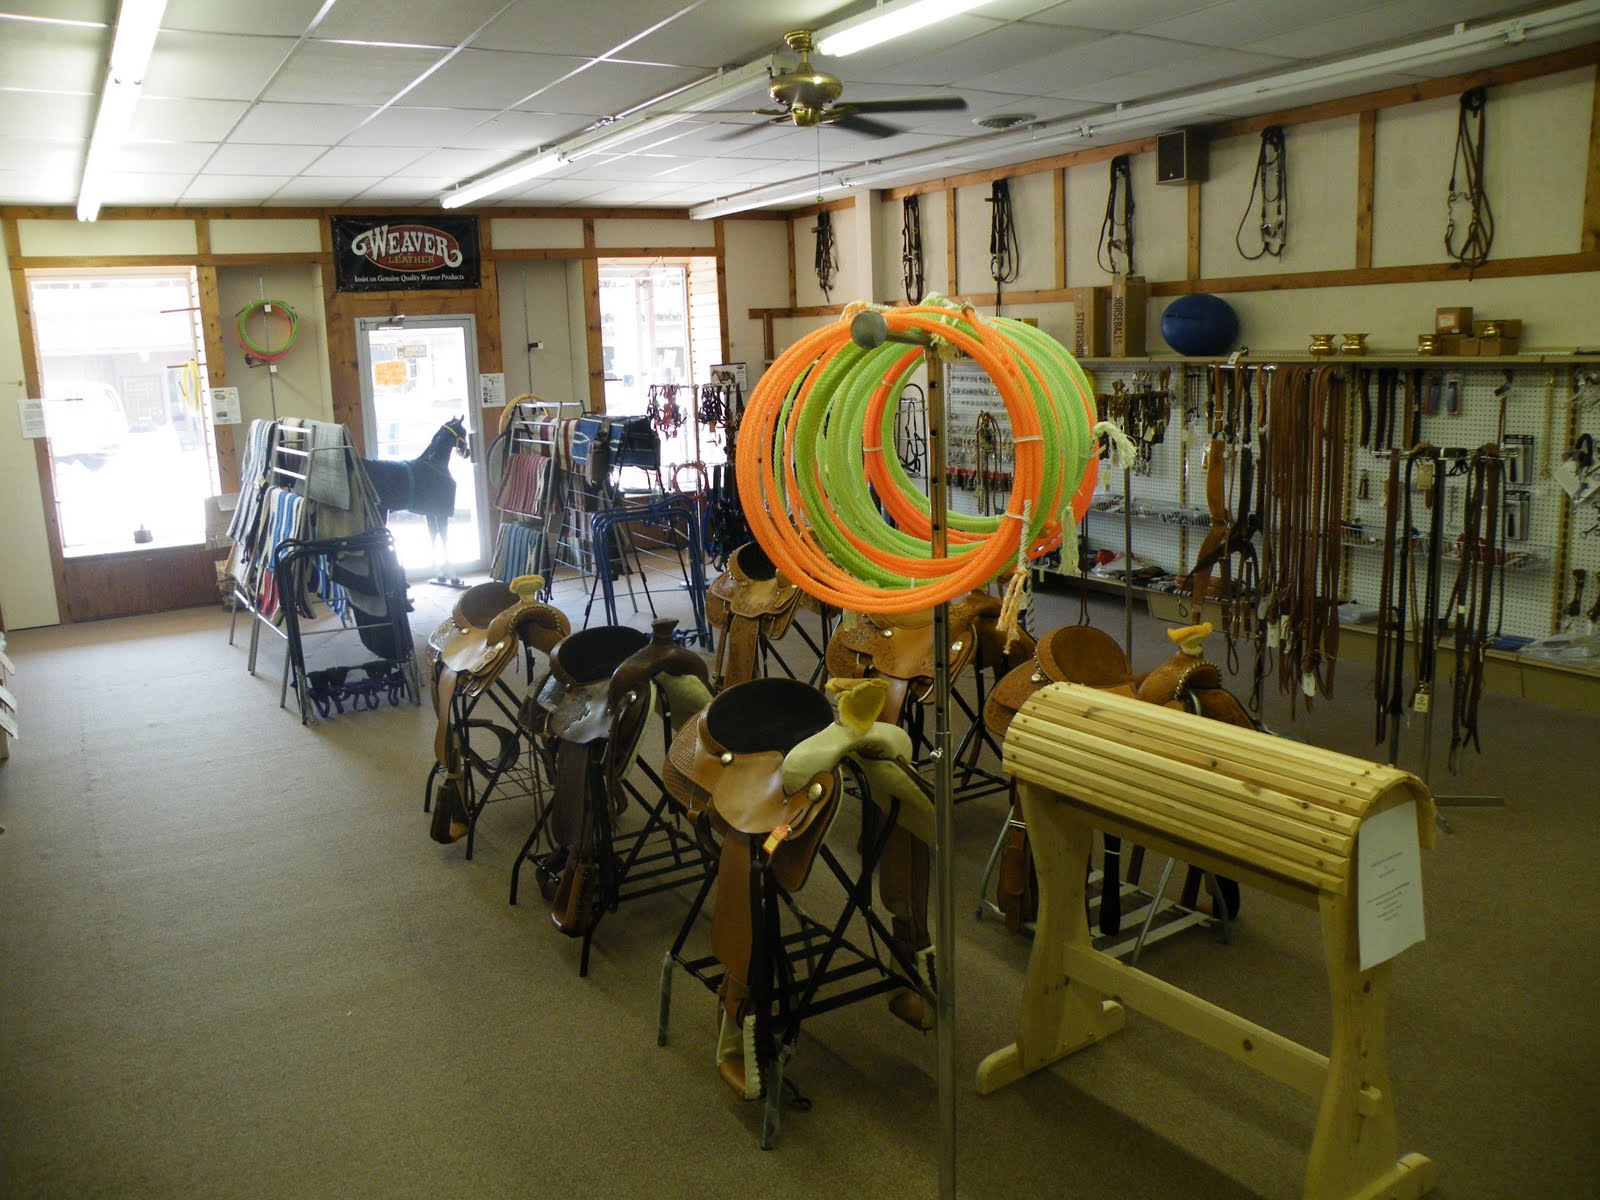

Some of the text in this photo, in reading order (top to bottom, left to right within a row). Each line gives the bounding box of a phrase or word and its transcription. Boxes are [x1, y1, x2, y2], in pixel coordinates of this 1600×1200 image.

[352, 224, 463, 268] WEAVER
[388, 255, 435, 264] LEATHER
[354, 275, 369, 283] Insist
[377, 274, 400, 282] Genuine
[400, 274, 420, 282] Quality
[420, 273, 441, 281] Weaver
[441, 273, 465, 281] Products
[1075, 311, 1085, 358] HORSEBALLS
